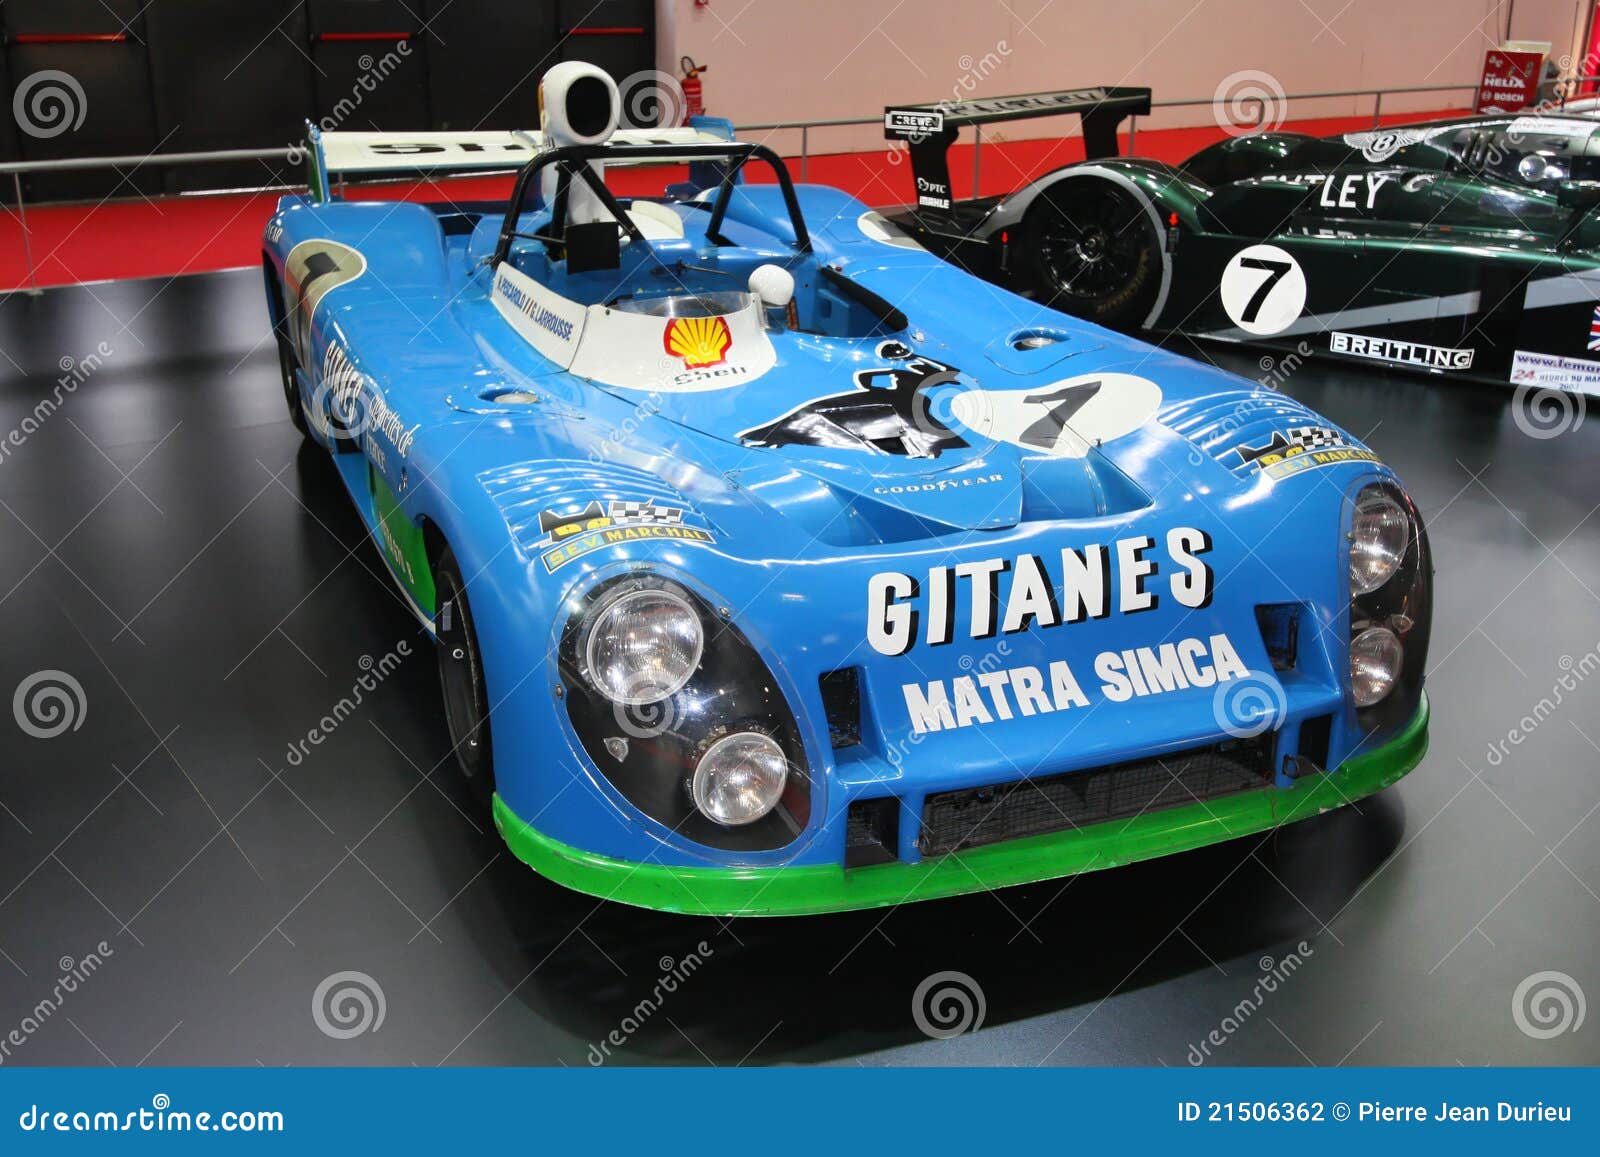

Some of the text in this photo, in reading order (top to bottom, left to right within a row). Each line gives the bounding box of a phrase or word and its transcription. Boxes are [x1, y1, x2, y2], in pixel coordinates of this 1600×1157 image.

[1484, 77, 1525, 88] HELIX
[1494, 92, 1524, 102] BOSCH
[929, 183, 947, 194] PTC
[919, 195, 950, 209] MAHLE
[1240, 257, 1292, 323] 7
[1333, 336, 1470, 367] BREITLING
[674, 366, 747, 385] Shell
[1513, 369, 1536, 381] 24
[1019, 380, 1102, 449] 7
[873, 474, 1003, 494] GOODYEAR
[606, 525, 705, 543] MARCHAL
[867, 527, 1214, 657] GITANES
[902, 633, 1251, 735] MATRA SIMCA
